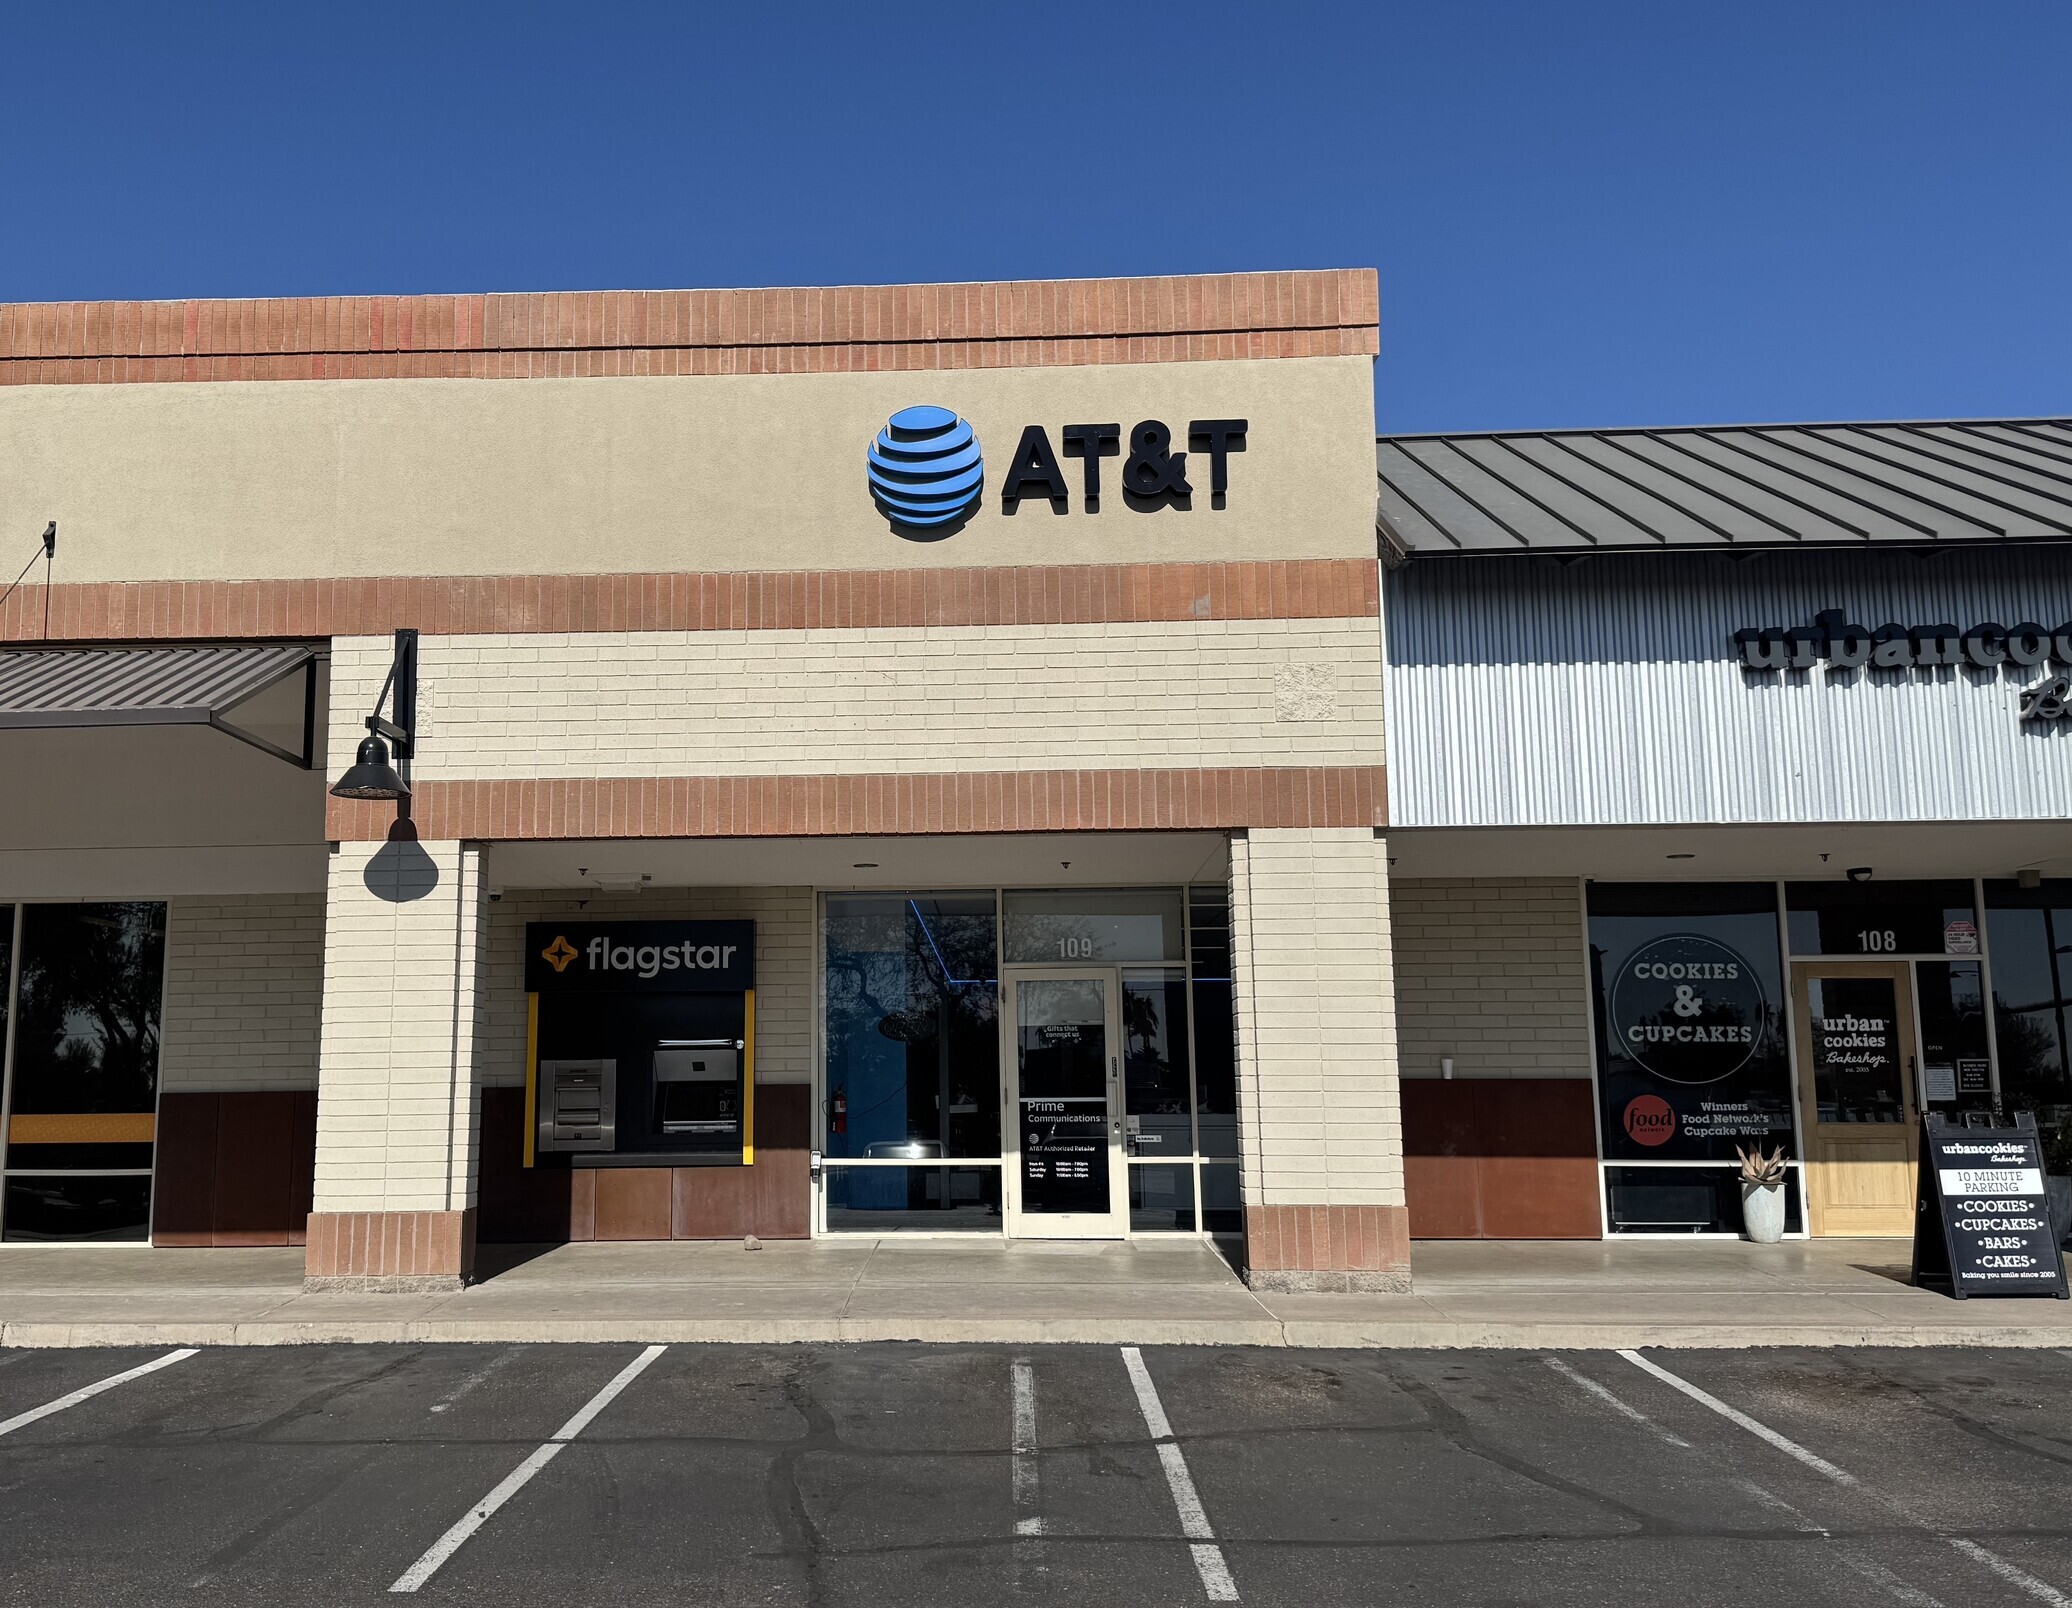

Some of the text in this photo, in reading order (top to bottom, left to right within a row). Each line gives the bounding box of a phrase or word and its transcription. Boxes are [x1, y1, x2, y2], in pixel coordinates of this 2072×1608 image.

[1001, 419, 1249, 502] AT&T
[1056, 937, 1092, 958] 109
[1857, 930, 1896, 952] 108
[586, 936, 737, 979] flagstar
[1634, 962, 1738, 979] COOKIES
[1673, 984, 1703, 1018] &
[1822, 1013, 1885, 1032] urban
[1628, 1025, 1752, 1043] CUPCAKES
[1824, 1033, 1886, 1047] cookies
[1027, 1100, 1065, 1112] Prime
[1700, 1102, 1748, 1111] Winners
[1028, 1114, 1101, 1123] Communications
[1628, 1107, 1673, 1134] food
[1681, 1114, 1710, 1124] Food
[1684, 1126, 1737, 1137] Cupcake
[1941, 1142, 2025, 1154] urbancookies
[1957, 1171, 2023, 1182] 10 MINUTE
[1964, 1182, 2019, 1193] PARKING
[1963, 1200, 2028, 1212] COOKIES
[1961, 1218, 2038, 1231] CUPCAKES
[1983, 1236, 2021, 1249] BARS
[1982, 1255, 2030, 1268] CAKES
